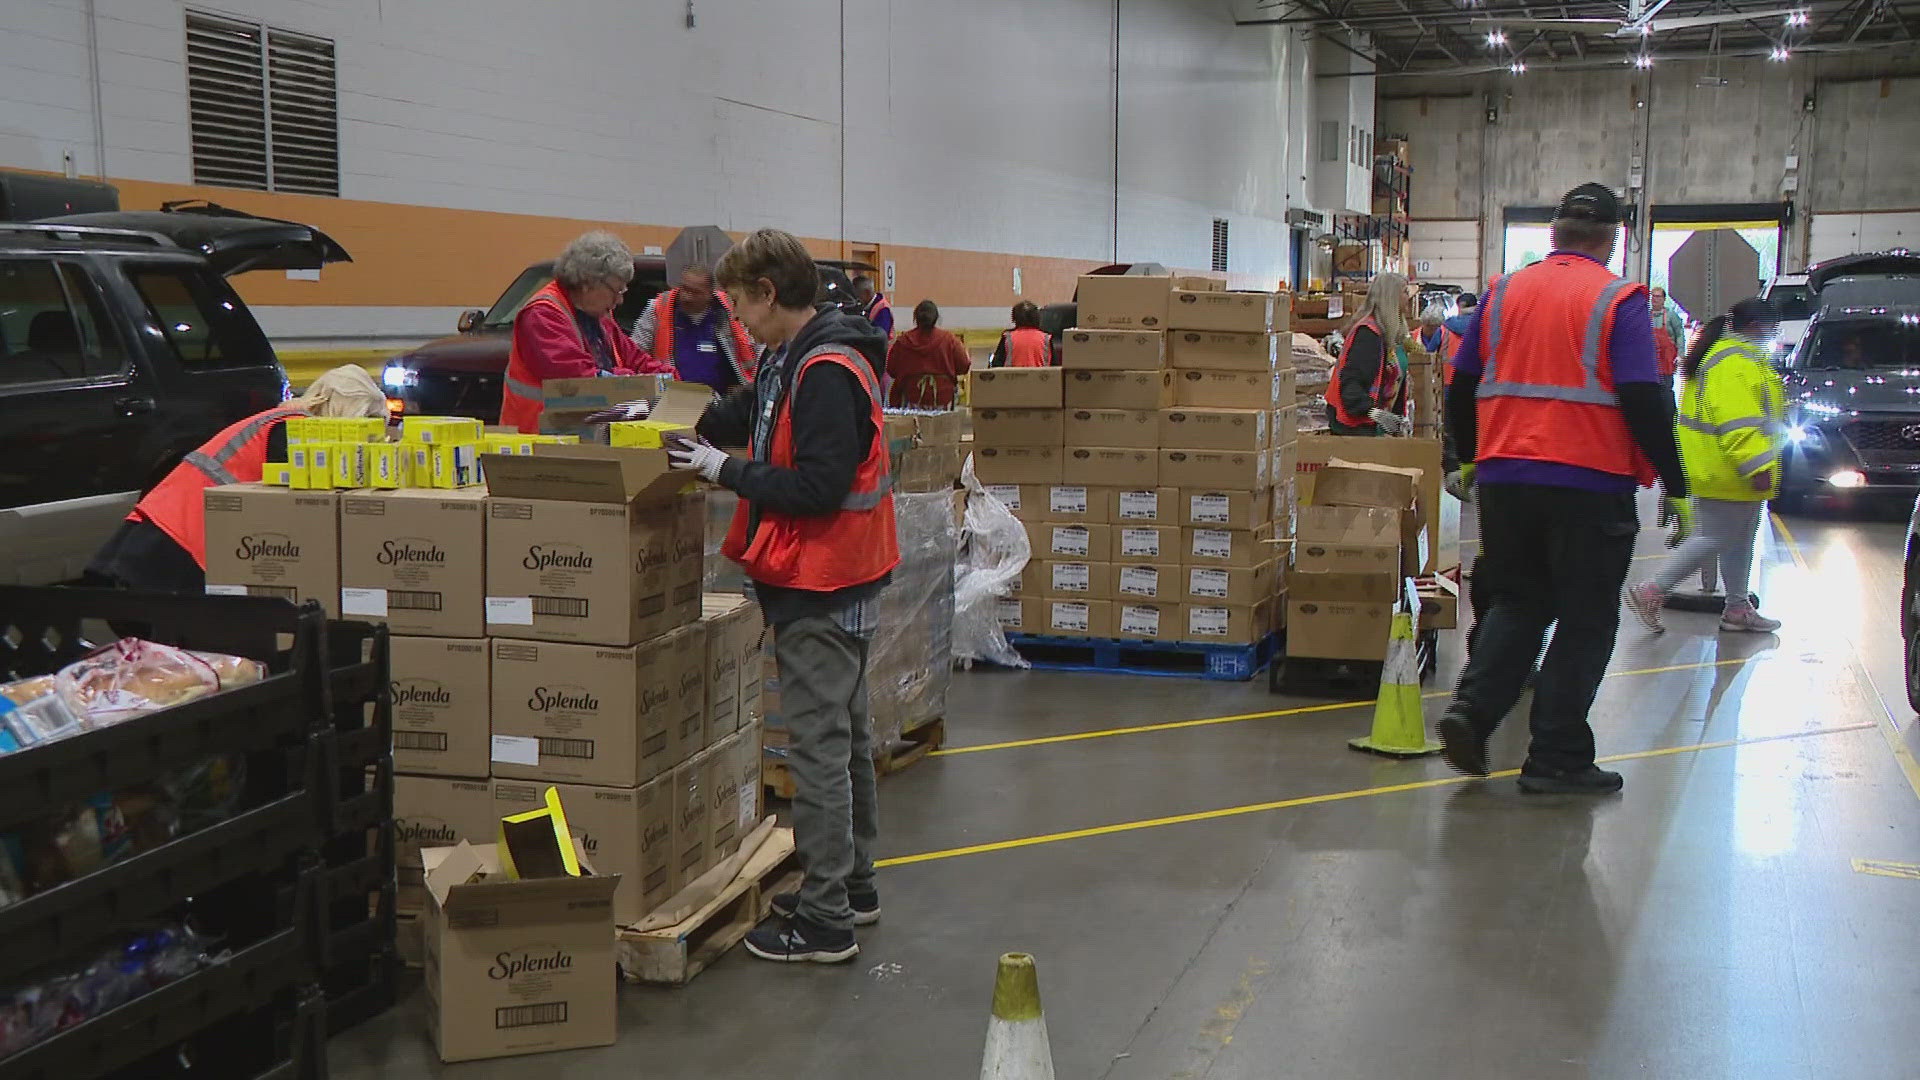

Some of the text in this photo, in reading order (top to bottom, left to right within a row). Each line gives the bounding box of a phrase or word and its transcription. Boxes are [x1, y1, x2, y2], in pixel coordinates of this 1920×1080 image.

[887, 265, 893, 287] 9
[1417, 261, 1430, 272] 10
[236, 536, 301, 561] Splenda
[377, 541, 445, 566] Splenda
[523, 545, 593, 571] Splenda
[636, 545, 668, 574] Splenda
[528, 687, 599, 712] Splenda
[640, 685, 669, 715] Splenda
[713, 779, 737, 809] Splenda
[488, 951, 572, 980] Splenda
